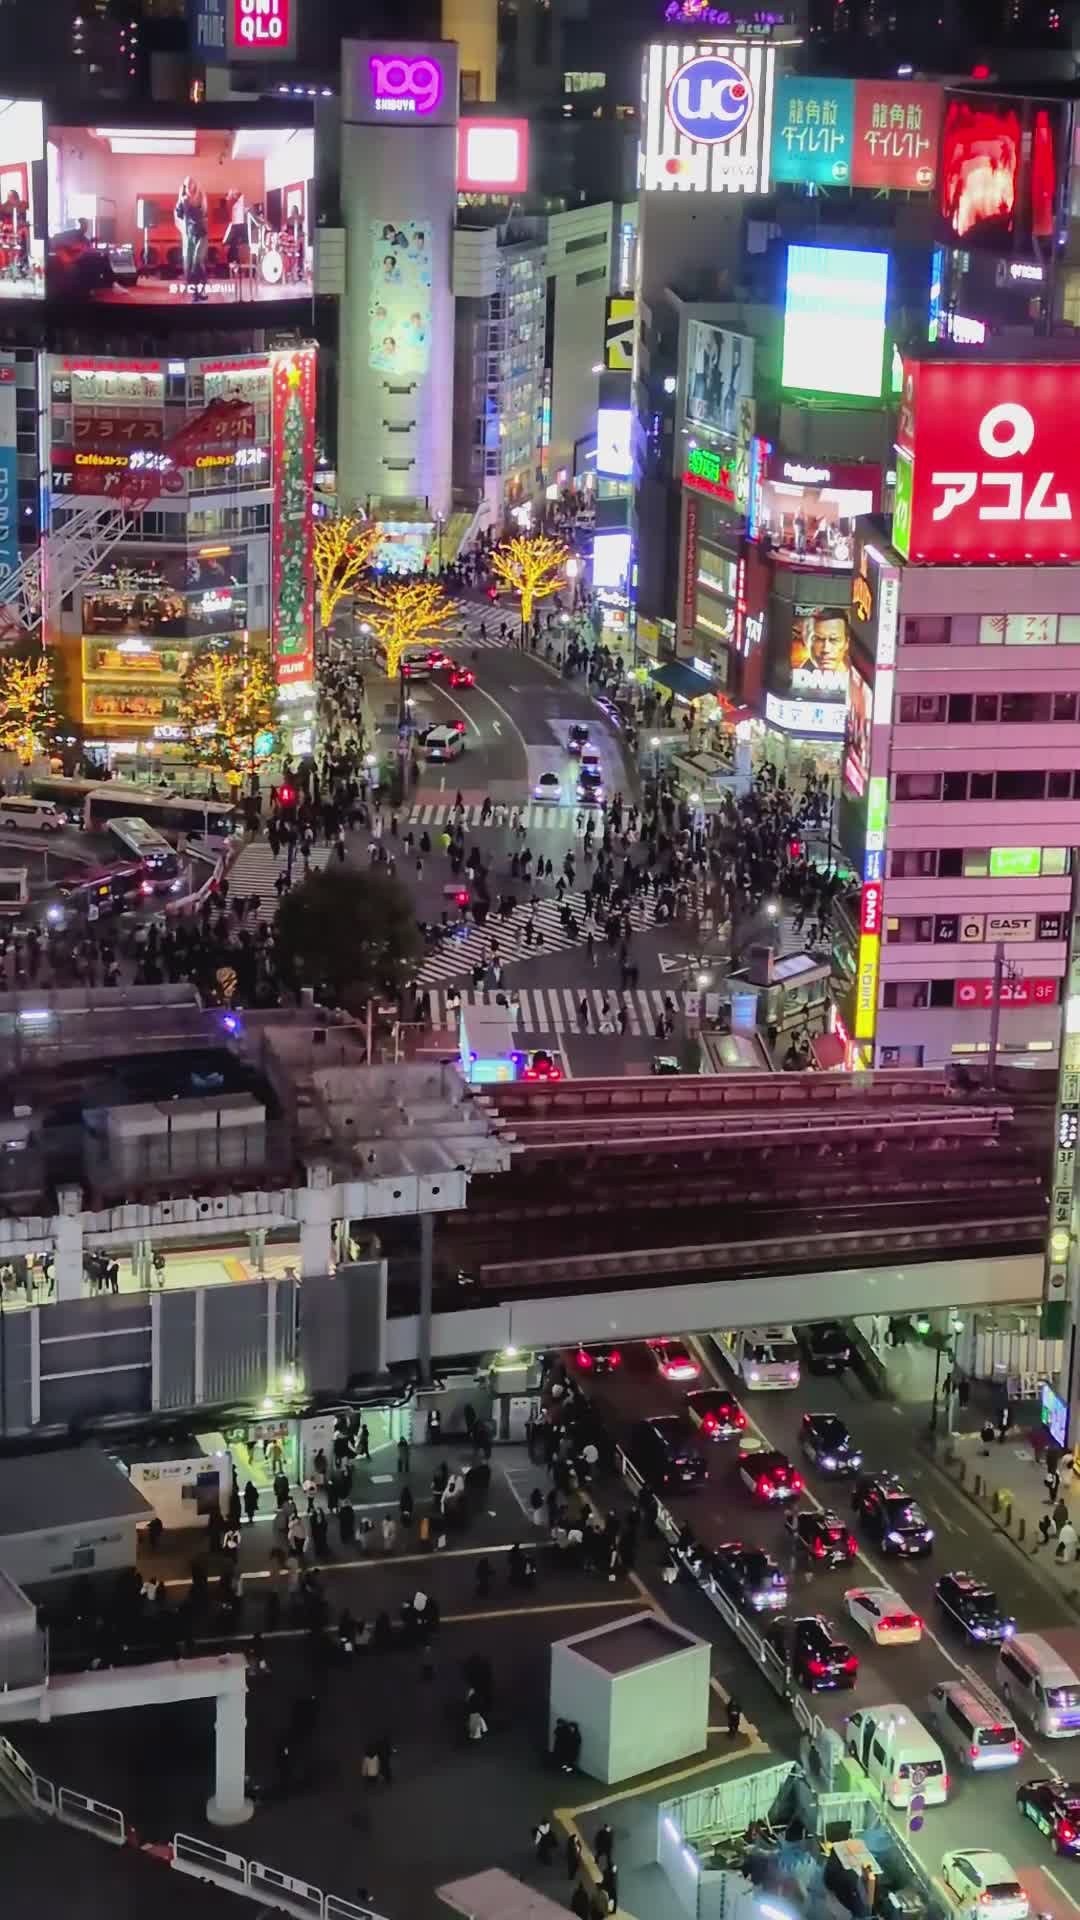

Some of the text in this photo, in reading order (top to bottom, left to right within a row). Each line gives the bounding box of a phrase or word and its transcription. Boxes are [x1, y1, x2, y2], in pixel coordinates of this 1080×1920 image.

[241, 16, 282, 42] QLO
[371, 59, 439, 111] 109
[788, 100, 839, 126] 龍角散
[871, 103, 923, 129] 龍角散
[781, 126, 845, 153] ダイレクト
[864, 130, 929, 158] ダイレクト
[53, 472, 73, 486] 7F
[932, 472, 1072, 521] アコム
[990, 919, 1032, 929] EAST
[1035, 985, 1053, 998] 3F
